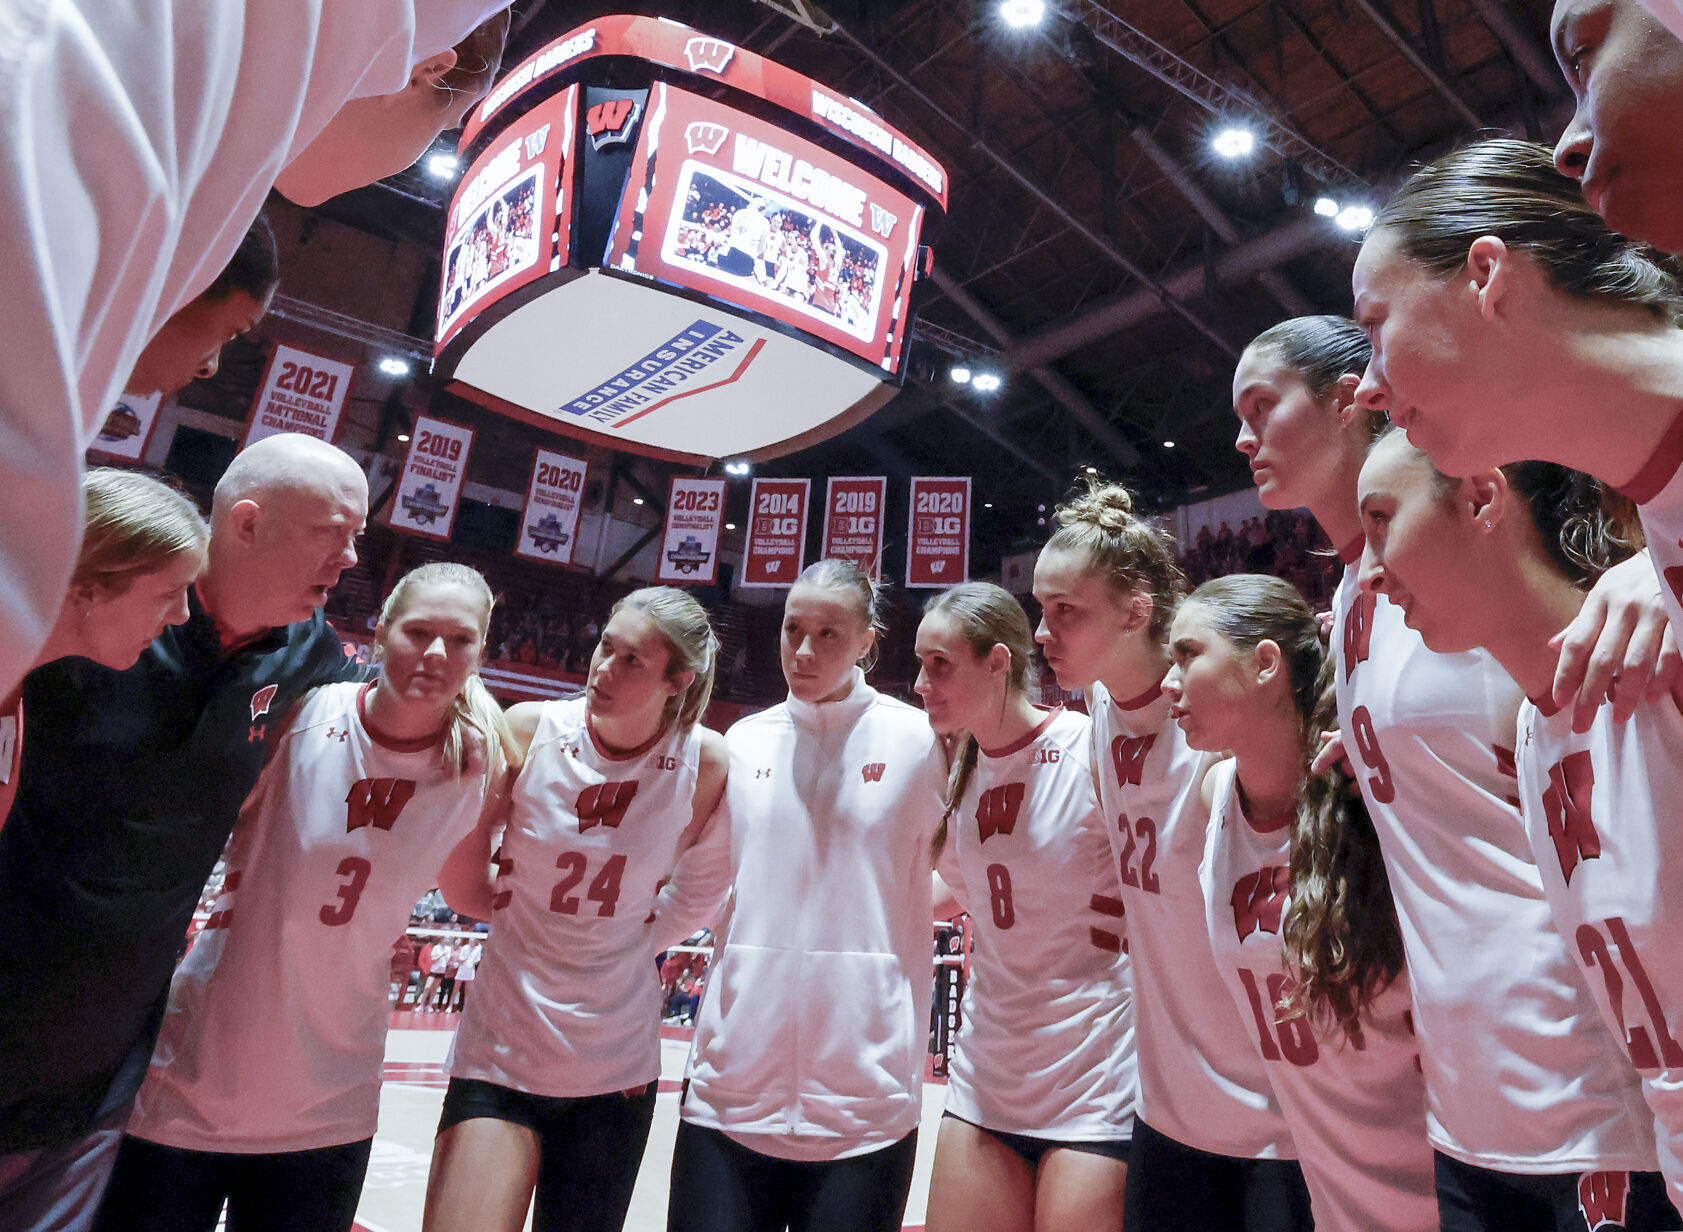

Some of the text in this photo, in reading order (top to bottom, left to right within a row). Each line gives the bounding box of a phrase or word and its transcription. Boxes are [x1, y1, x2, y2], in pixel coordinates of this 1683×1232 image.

[684, 38, 735, 74] W
[525, 123, 550, 160] W
[586, 99, 641, 152] W
[813, 90, 892, 154] WISCONSIN
[685, 122, 897, 238] W WELCOME W
[276, 361, 338, 402] 2021
[572, 330, 706, 411] INSURANCE
[588, 330, 744, 423] AMERICAN FAMILY
[265, 401, 327, 427] NATIONAL
[271, 390, 331, 415] VOLLEYBALL
[417, 430, 462, 461] 2019
[410, 464, 456, 483] FINALIST
[537, 462, 582, 493] 2020
[673, 490, 719, 512] 2023
[758, 493, 799, 514] 2014
[835, 491, 876, 513] 2019
[917, 491, 963, 513] 2020
[765, 560, 781, 574] W
[930, 560, 946, 574] W
[862, 763, 886, 783] W
[1111, 733, 1158, 788] W
[1352, 705, 1395, 804] 9
[344, 778, 416, 833] W
[575, 780, 639, 834] W
[975, 782, 1025, 844] W
[1118, 813, 1161, 894] 22
[320, 856, 371, 926] 3
[550, 851, 627, 918] 24
[986, 863, 1015, 930] 8
[1576, 916, 1683, 1069] 21
[948, 970, 957, 1074] BADGER
